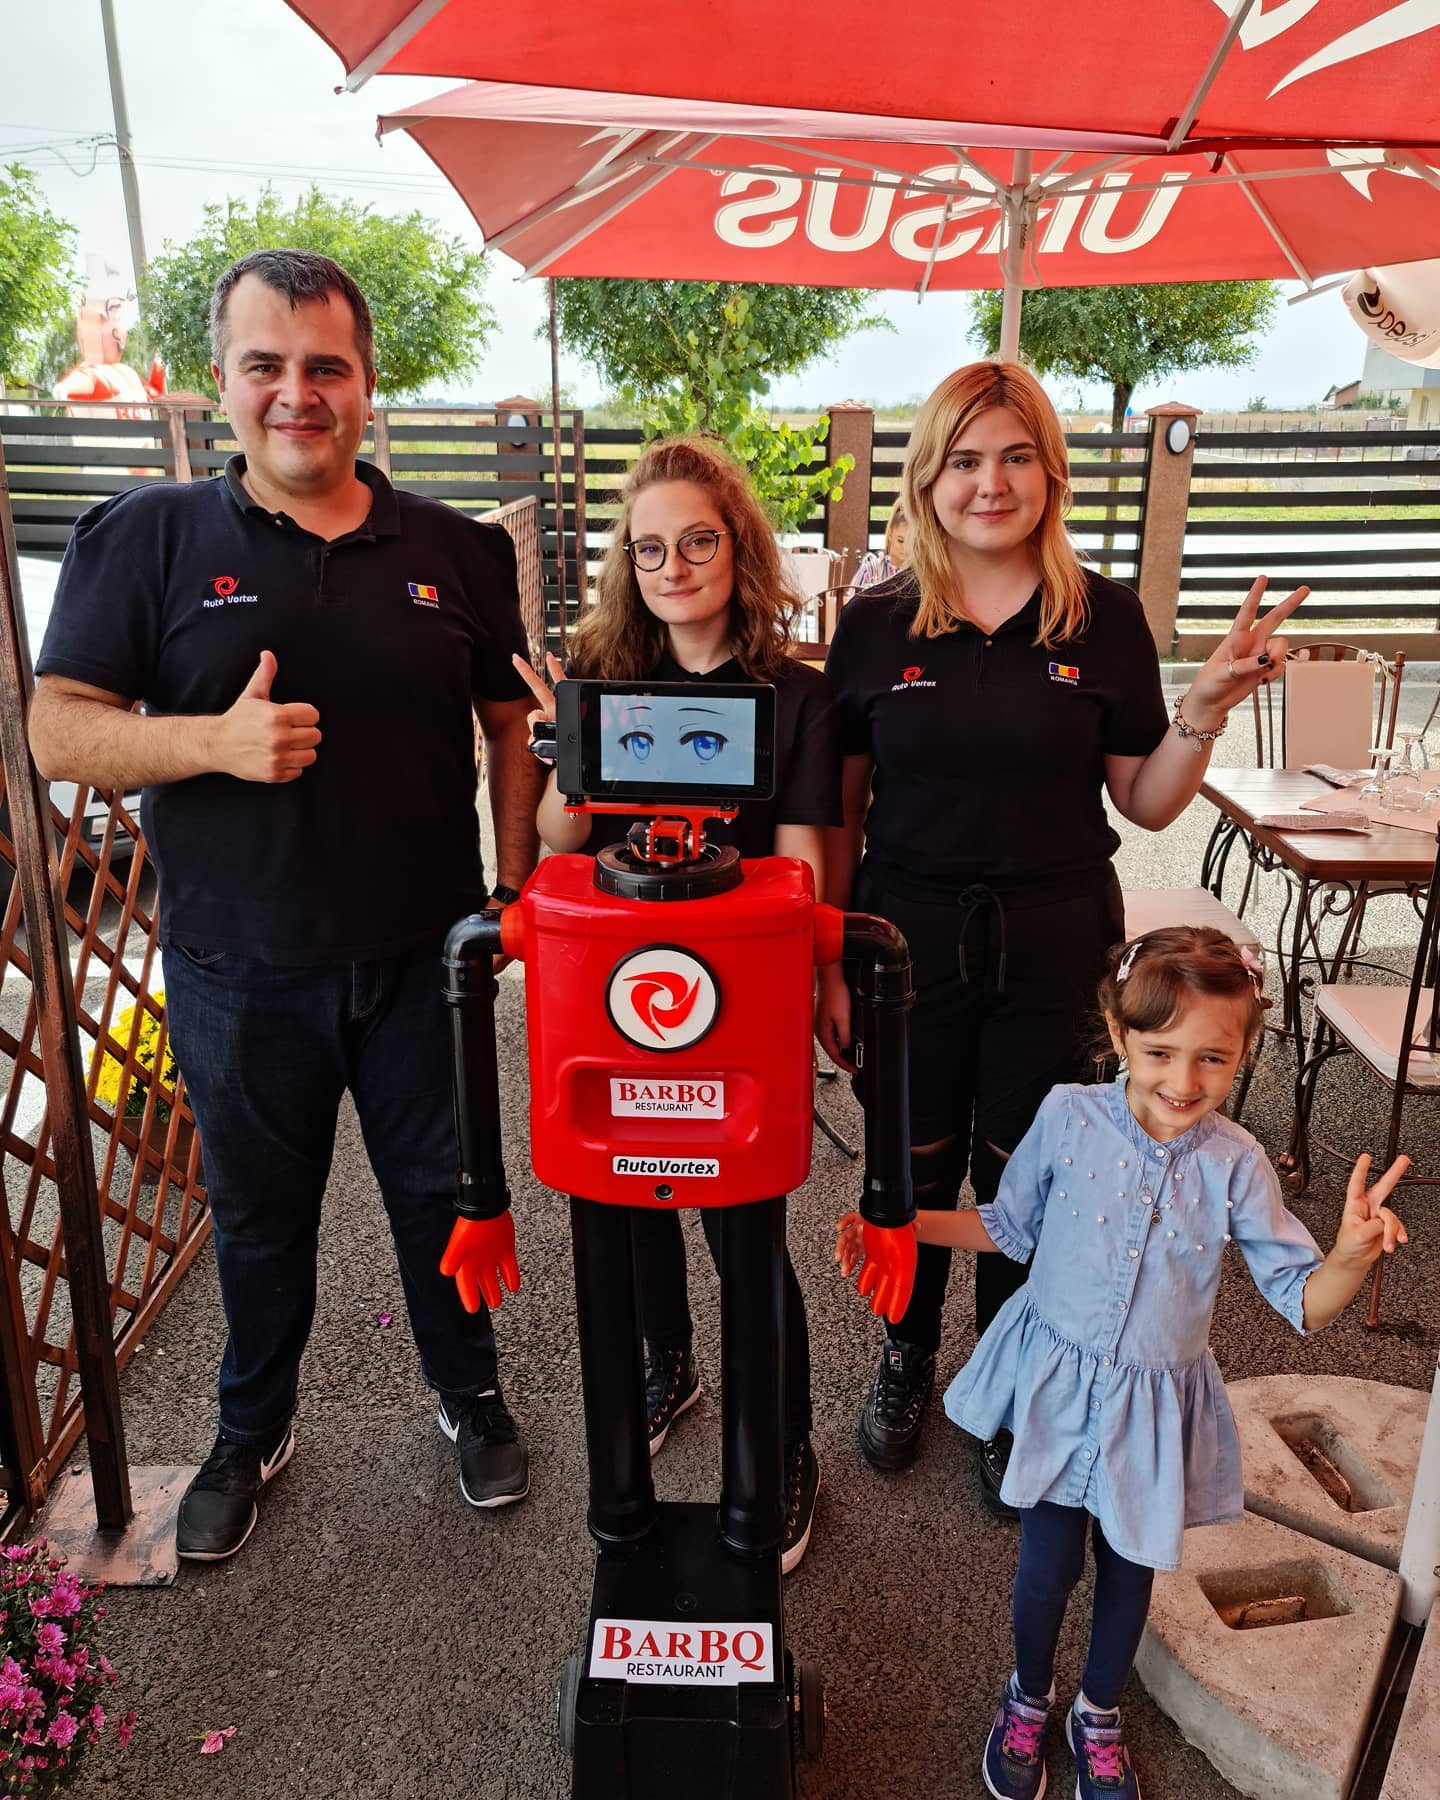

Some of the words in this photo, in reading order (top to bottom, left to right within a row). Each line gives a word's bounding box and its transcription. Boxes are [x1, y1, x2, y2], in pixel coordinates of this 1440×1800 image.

[203, 598, 225, 608] Auto
[227, 594, 258, 603] Vortex
[617, 1082, 718, 1108] BARBQ
[635, 1102, 694, 1112] RESTAURANT
[616, 1158, 716, 1175] AutoVortex
[600, 1625, 767, 1672] BARBQ
[626, 1662, 726, 1678] RESTAURANT
